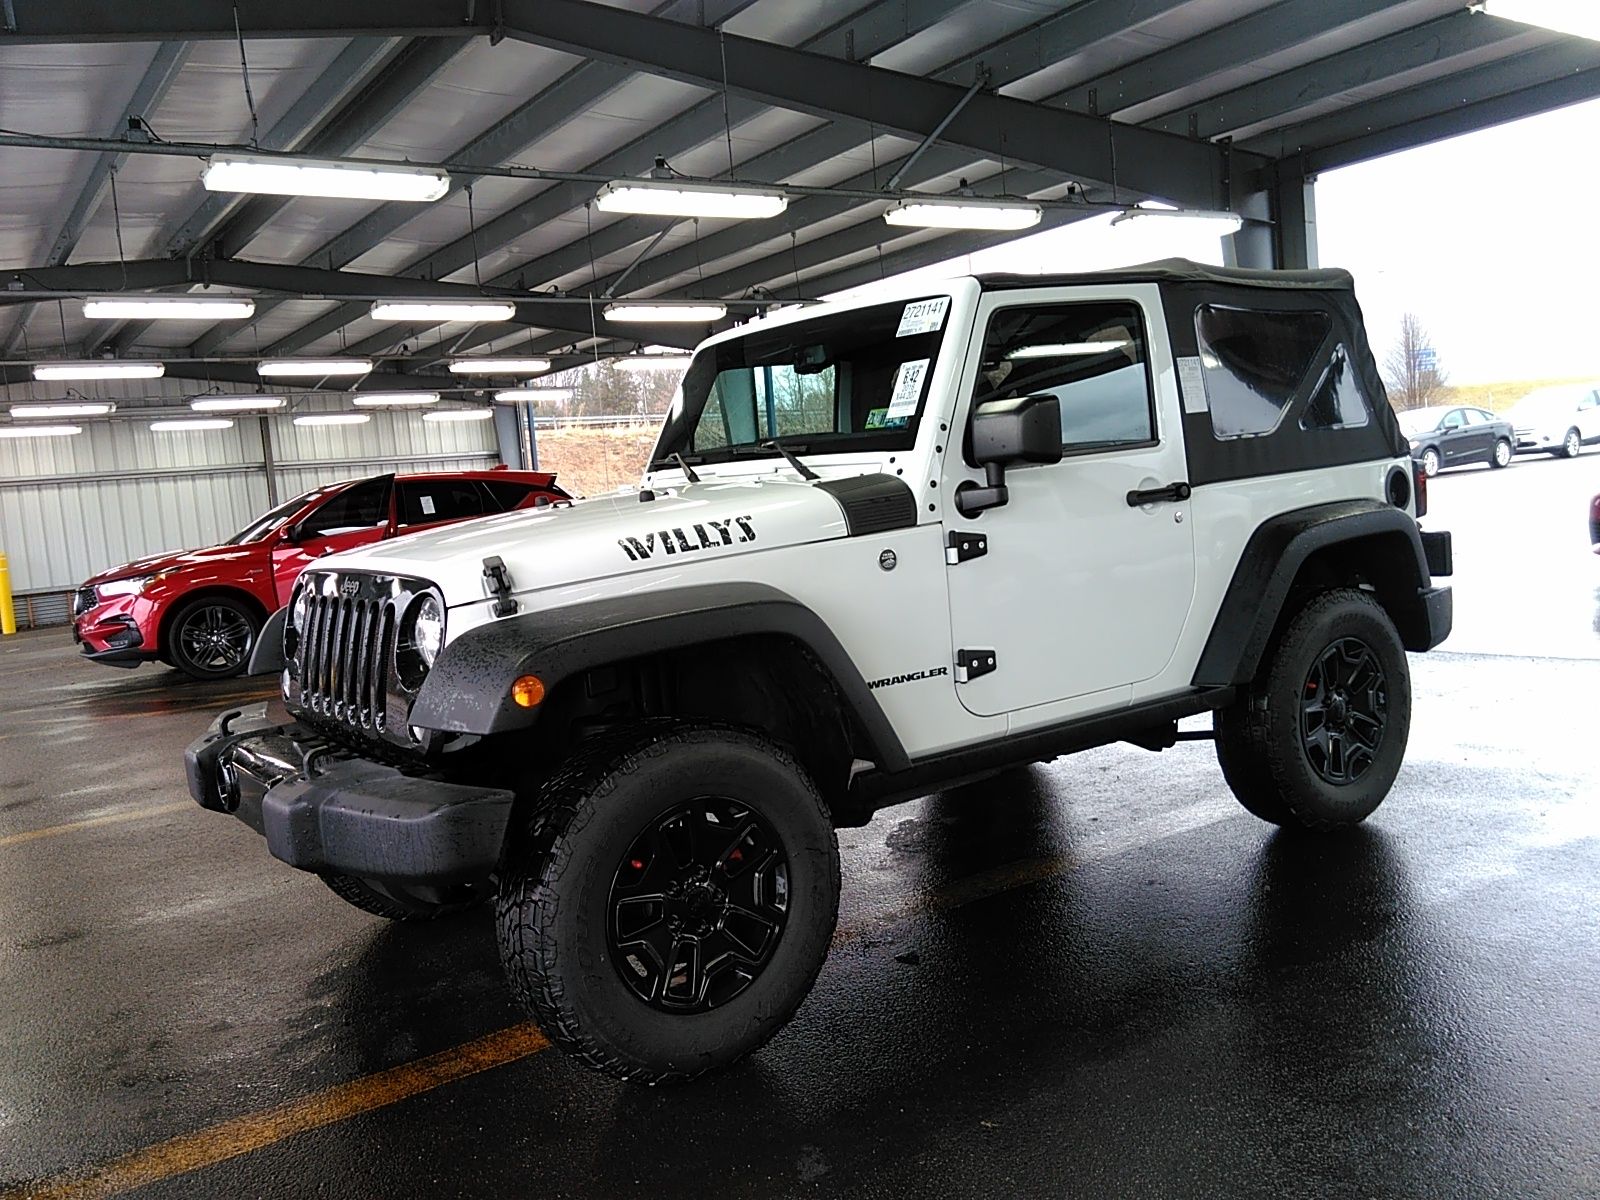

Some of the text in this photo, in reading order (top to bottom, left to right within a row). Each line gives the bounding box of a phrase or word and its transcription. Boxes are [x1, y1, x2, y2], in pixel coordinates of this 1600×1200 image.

[903, 301, 943, 319] 2721141
[618, 515, 756, 561] WILLYS
[340, 576, 359, 597] Jeep
[867, 667, 948, 689] WRANGLER
